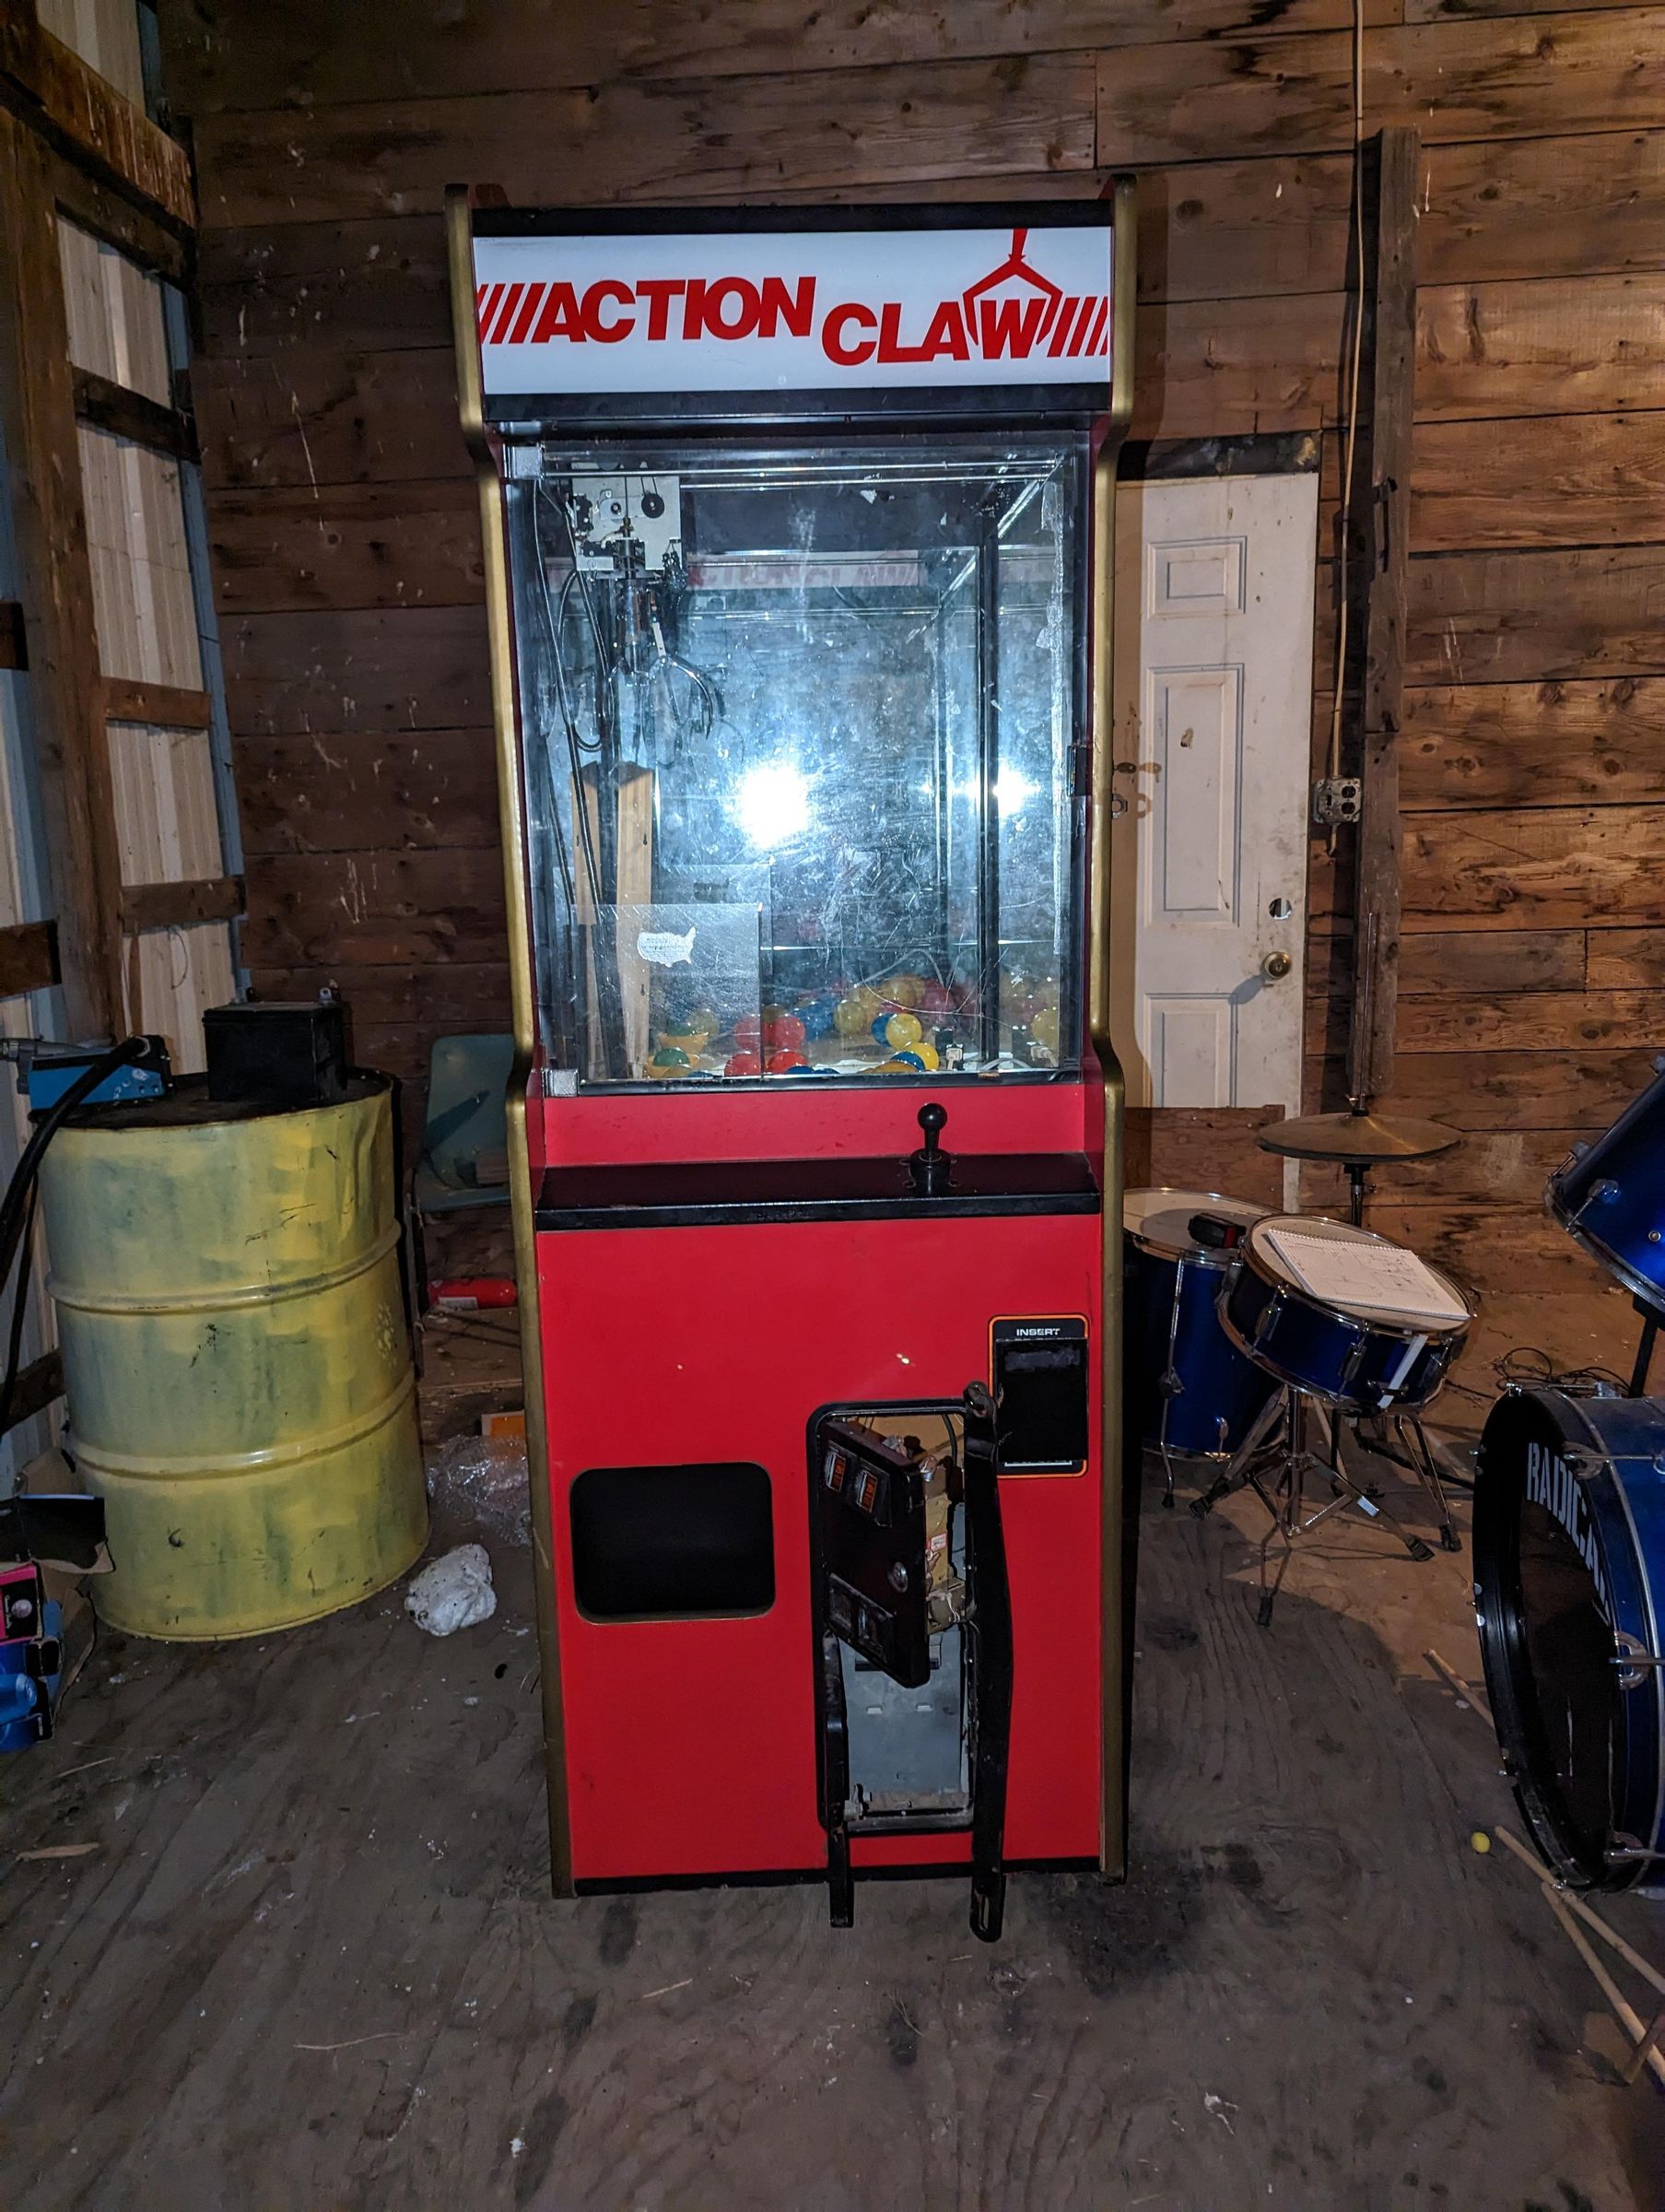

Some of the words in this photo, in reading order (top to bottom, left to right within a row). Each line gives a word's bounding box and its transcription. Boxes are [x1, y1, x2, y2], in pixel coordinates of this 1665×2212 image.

[531, 276, 816, 343] ACTION
[821, 298, 1048, 366] CLAW
[1015, 1328, 1061, 1336] INSERT
